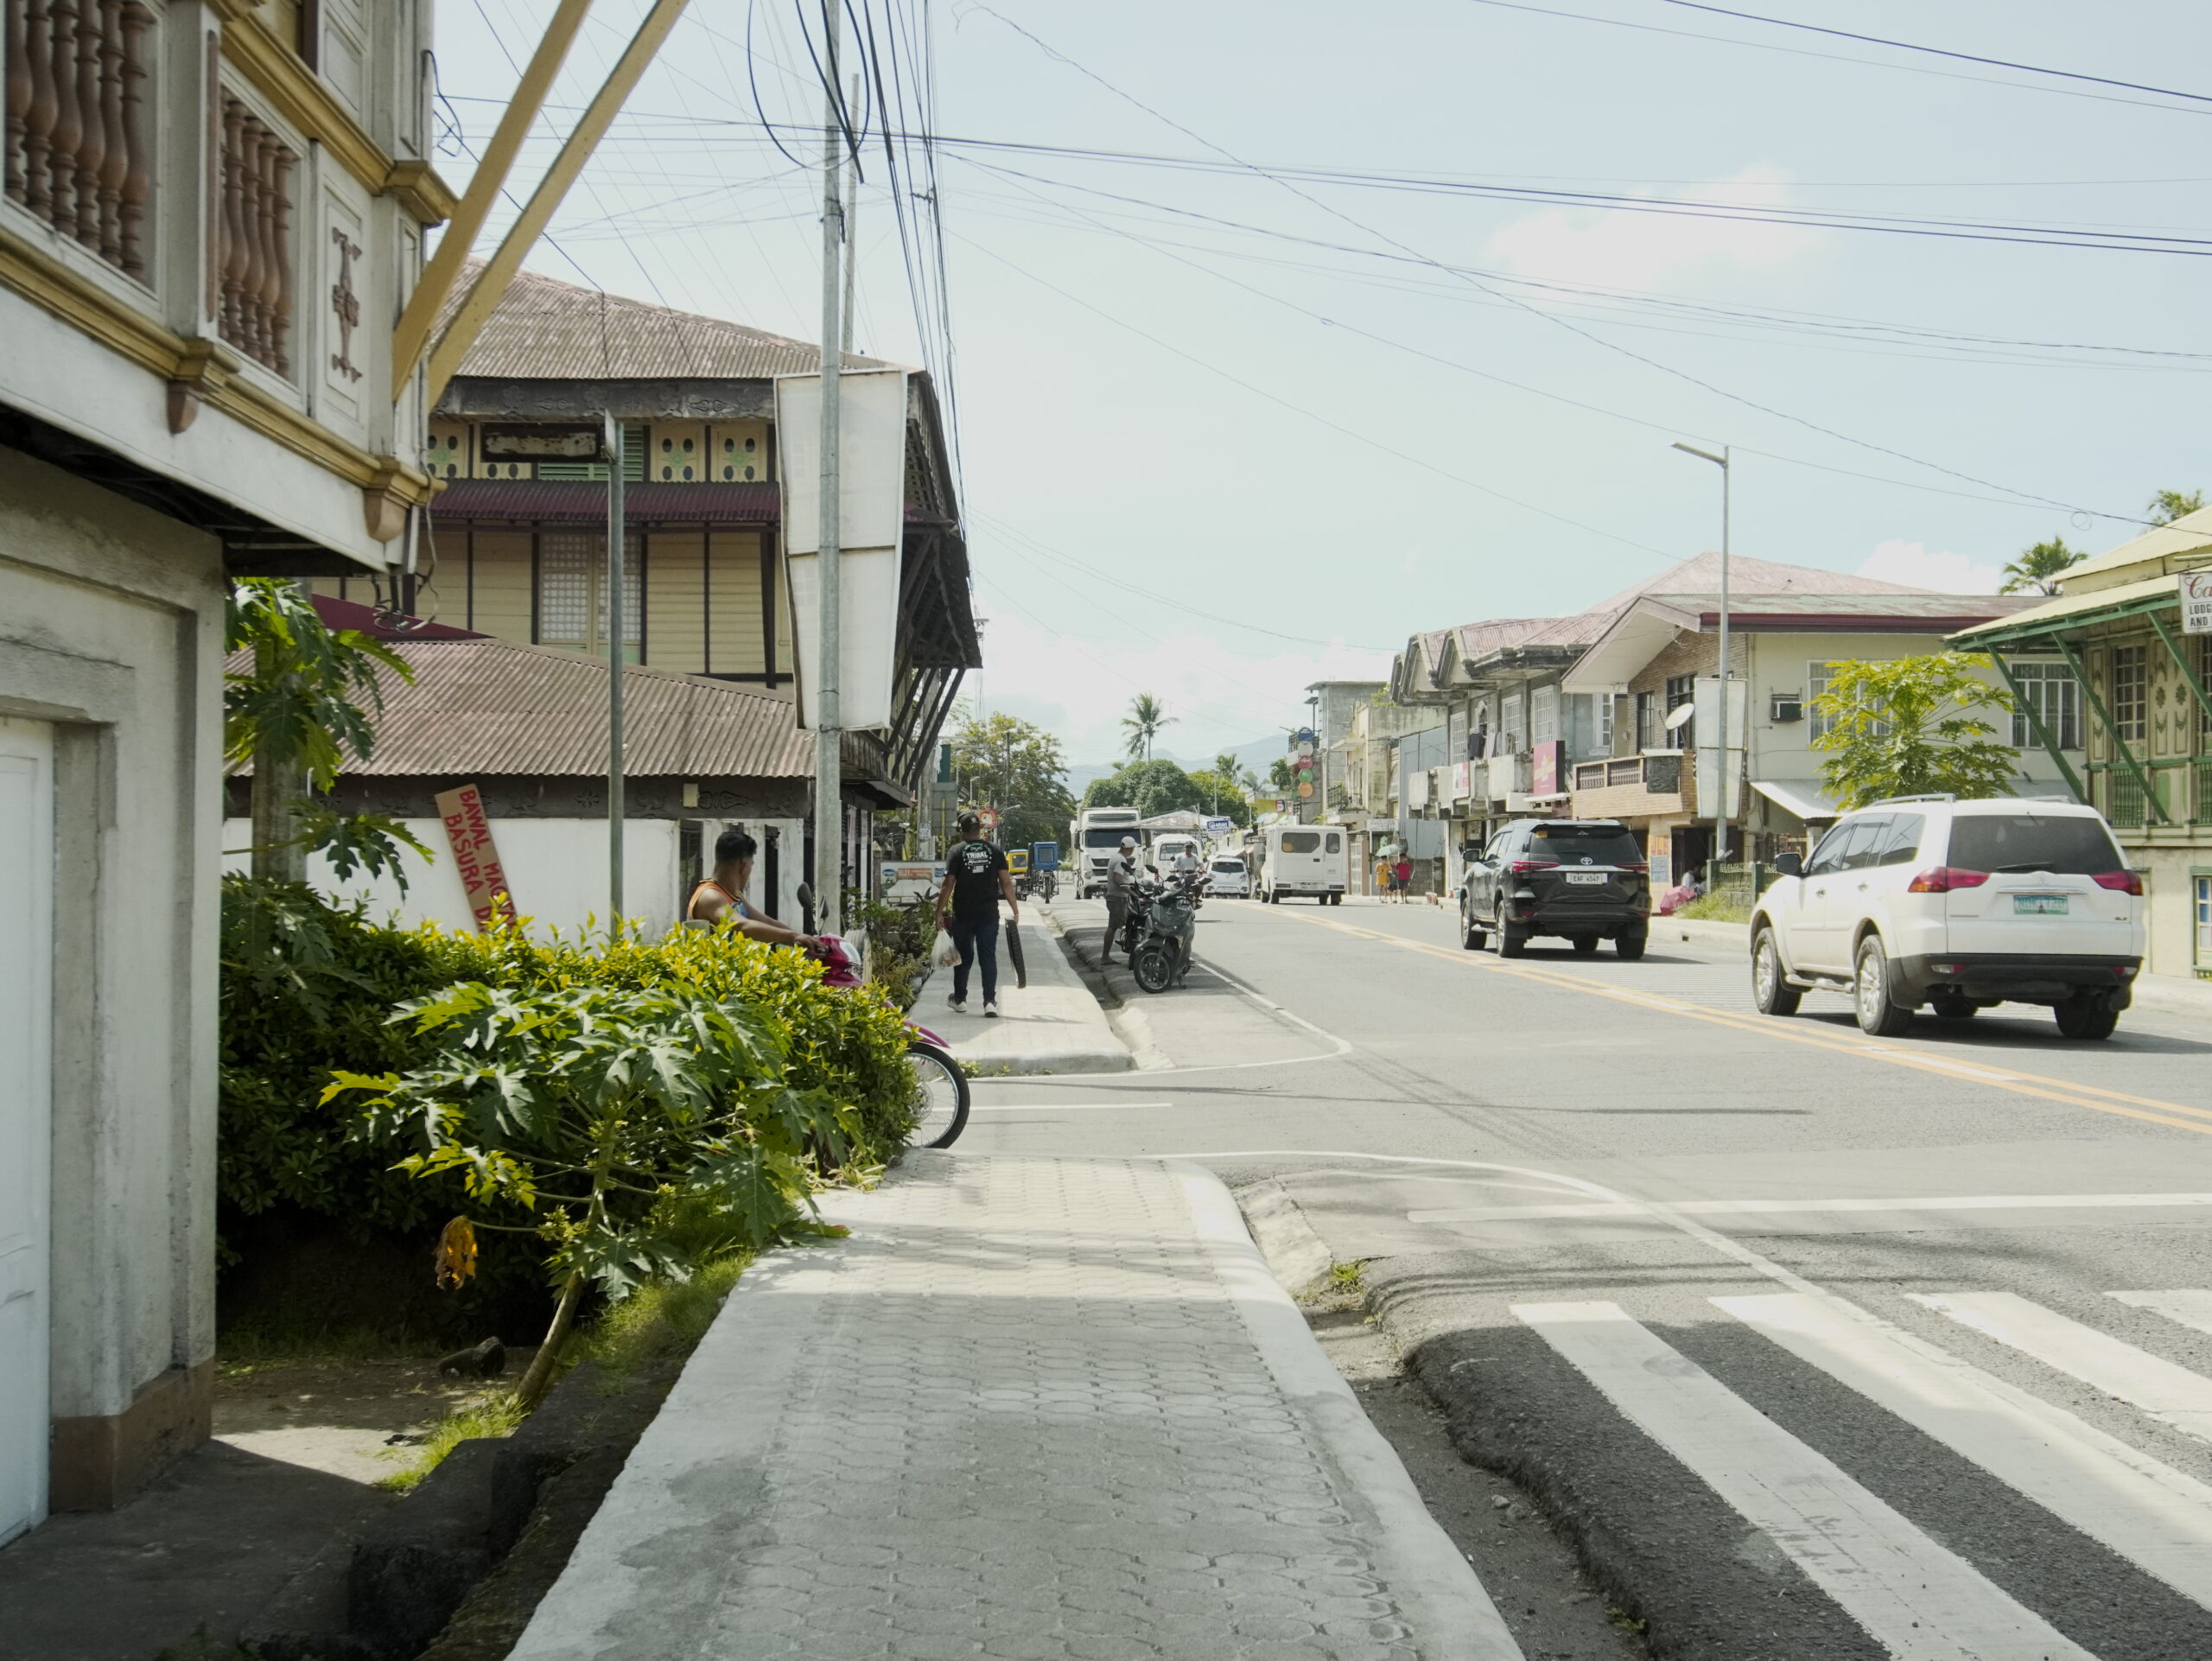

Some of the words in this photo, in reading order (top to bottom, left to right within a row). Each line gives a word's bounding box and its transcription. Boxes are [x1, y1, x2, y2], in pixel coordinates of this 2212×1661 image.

[2190, 617, 2208, 627] AND
[459, 790, 490, 850] BAWAL
[444, 813, 485, 894] BASURA
